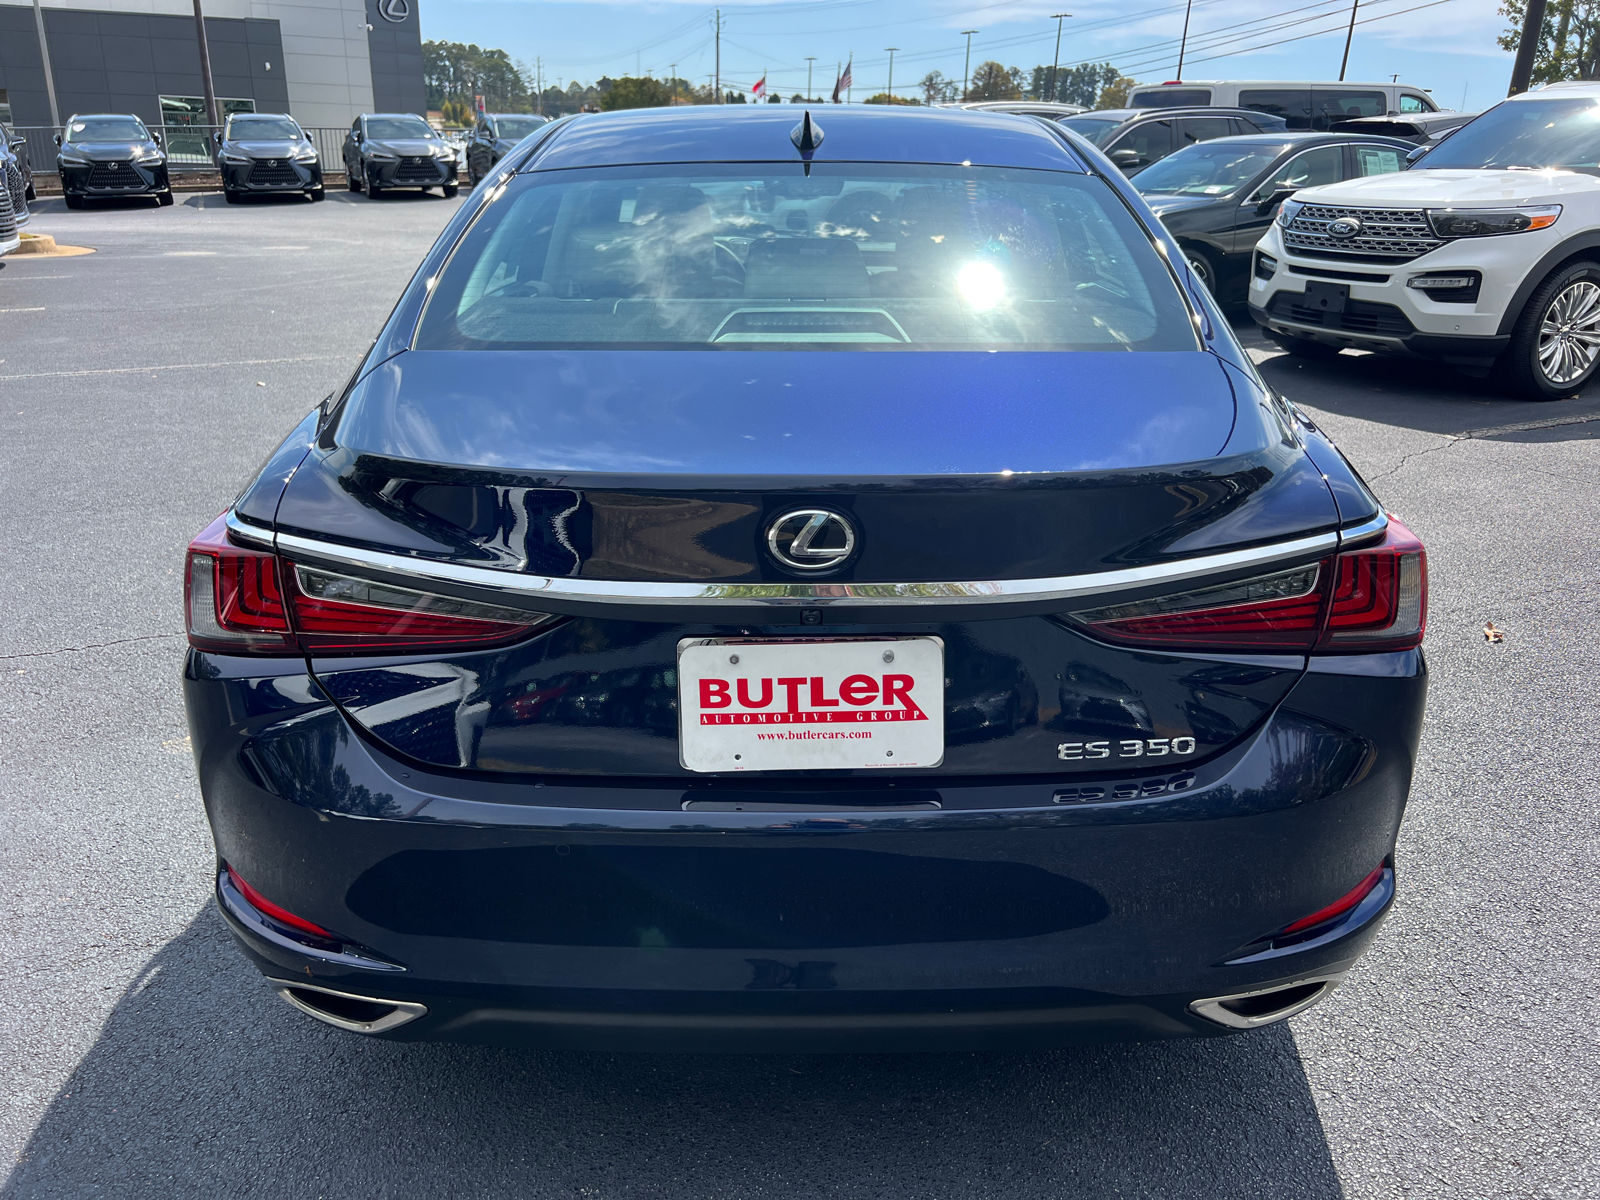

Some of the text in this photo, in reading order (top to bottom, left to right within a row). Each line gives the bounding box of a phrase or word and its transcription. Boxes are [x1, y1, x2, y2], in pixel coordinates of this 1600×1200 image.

[701, 710, 920, 724] AUTOMOTIVE GROUP
[757, 730, 872, 741] www.butlercars.com
[1057, 736, 1196, 760] ES 350
